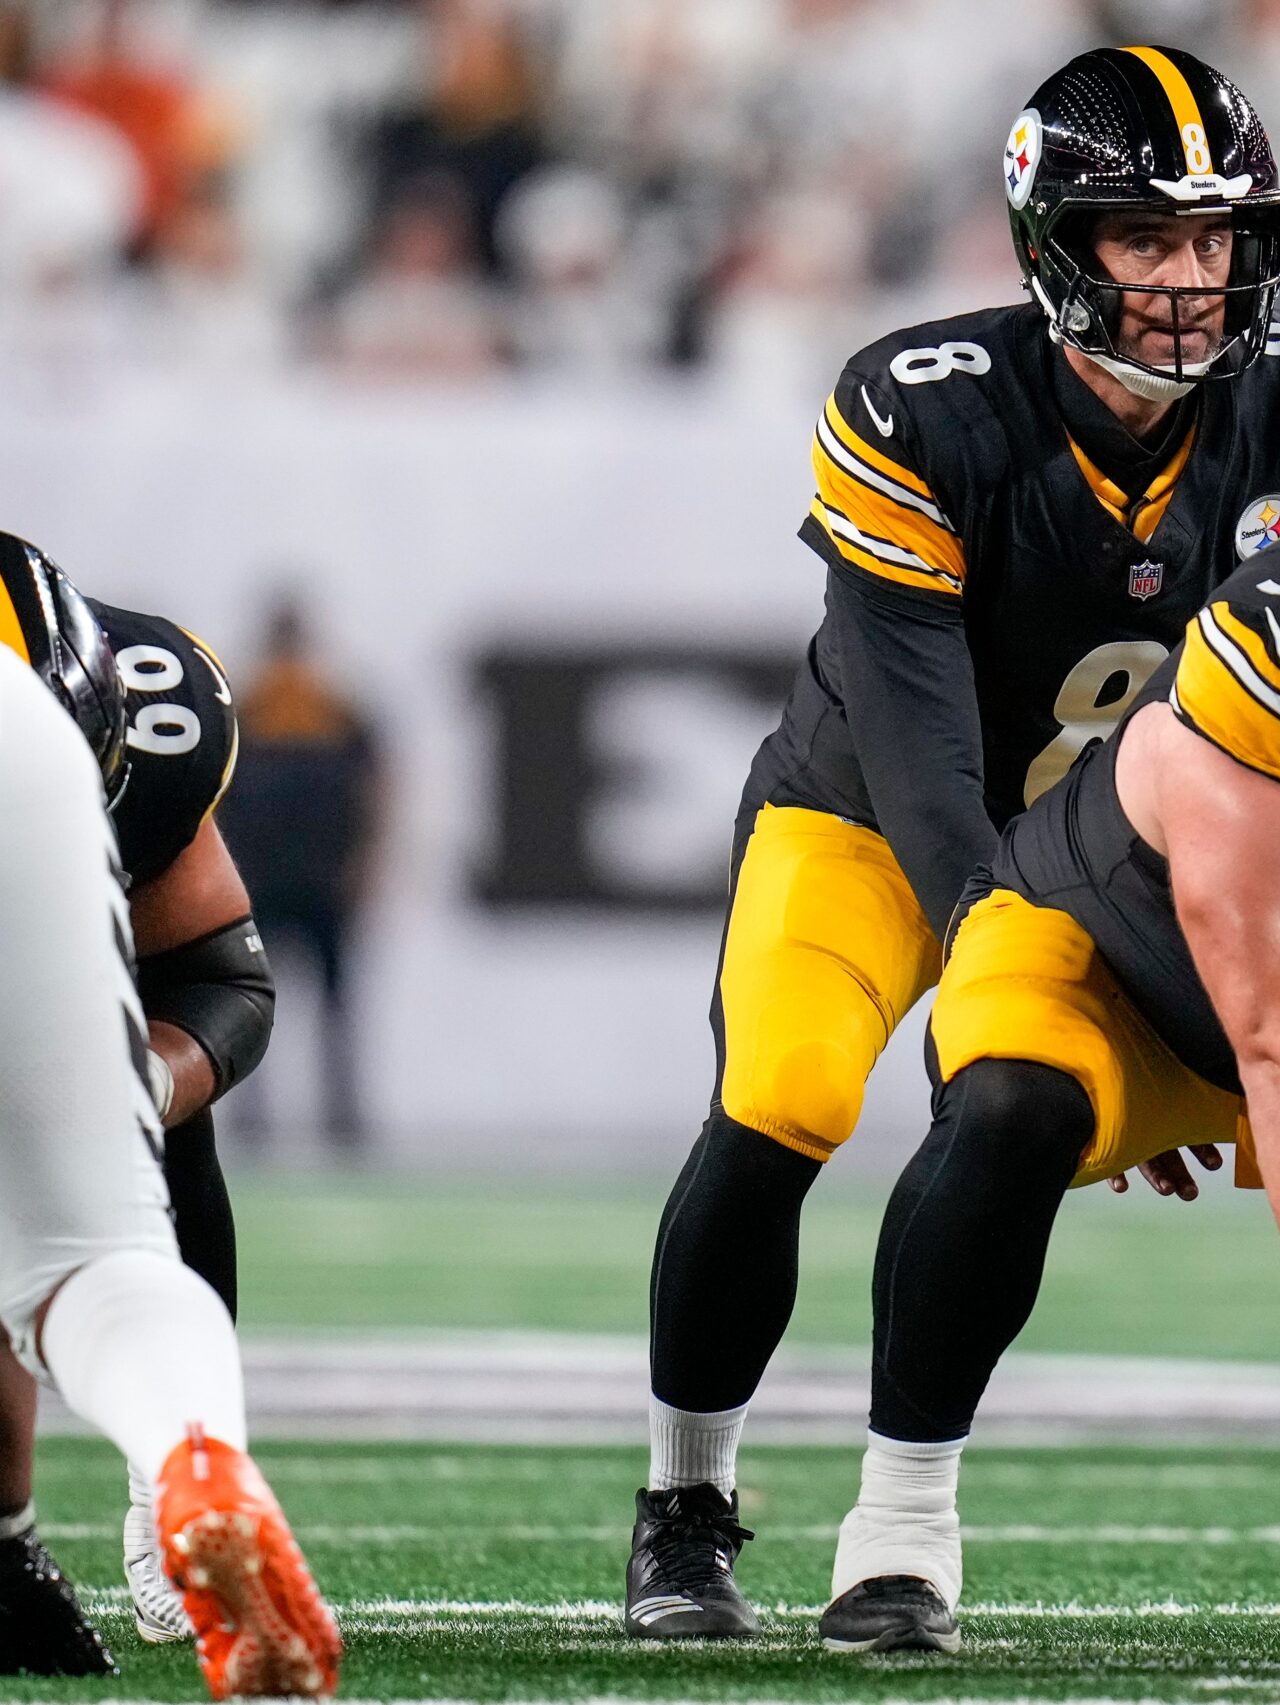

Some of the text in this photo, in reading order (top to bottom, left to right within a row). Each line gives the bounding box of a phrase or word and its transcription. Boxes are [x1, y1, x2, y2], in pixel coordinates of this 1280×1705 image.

[1182, 122, 1210, 174] 8
[1190, 180, 1217, 189] Steelers
[889, 341, 992, 385] 8
[1241, 527, 1267, 540] Steelers
[1133, 577, 1158, 594] NFL
